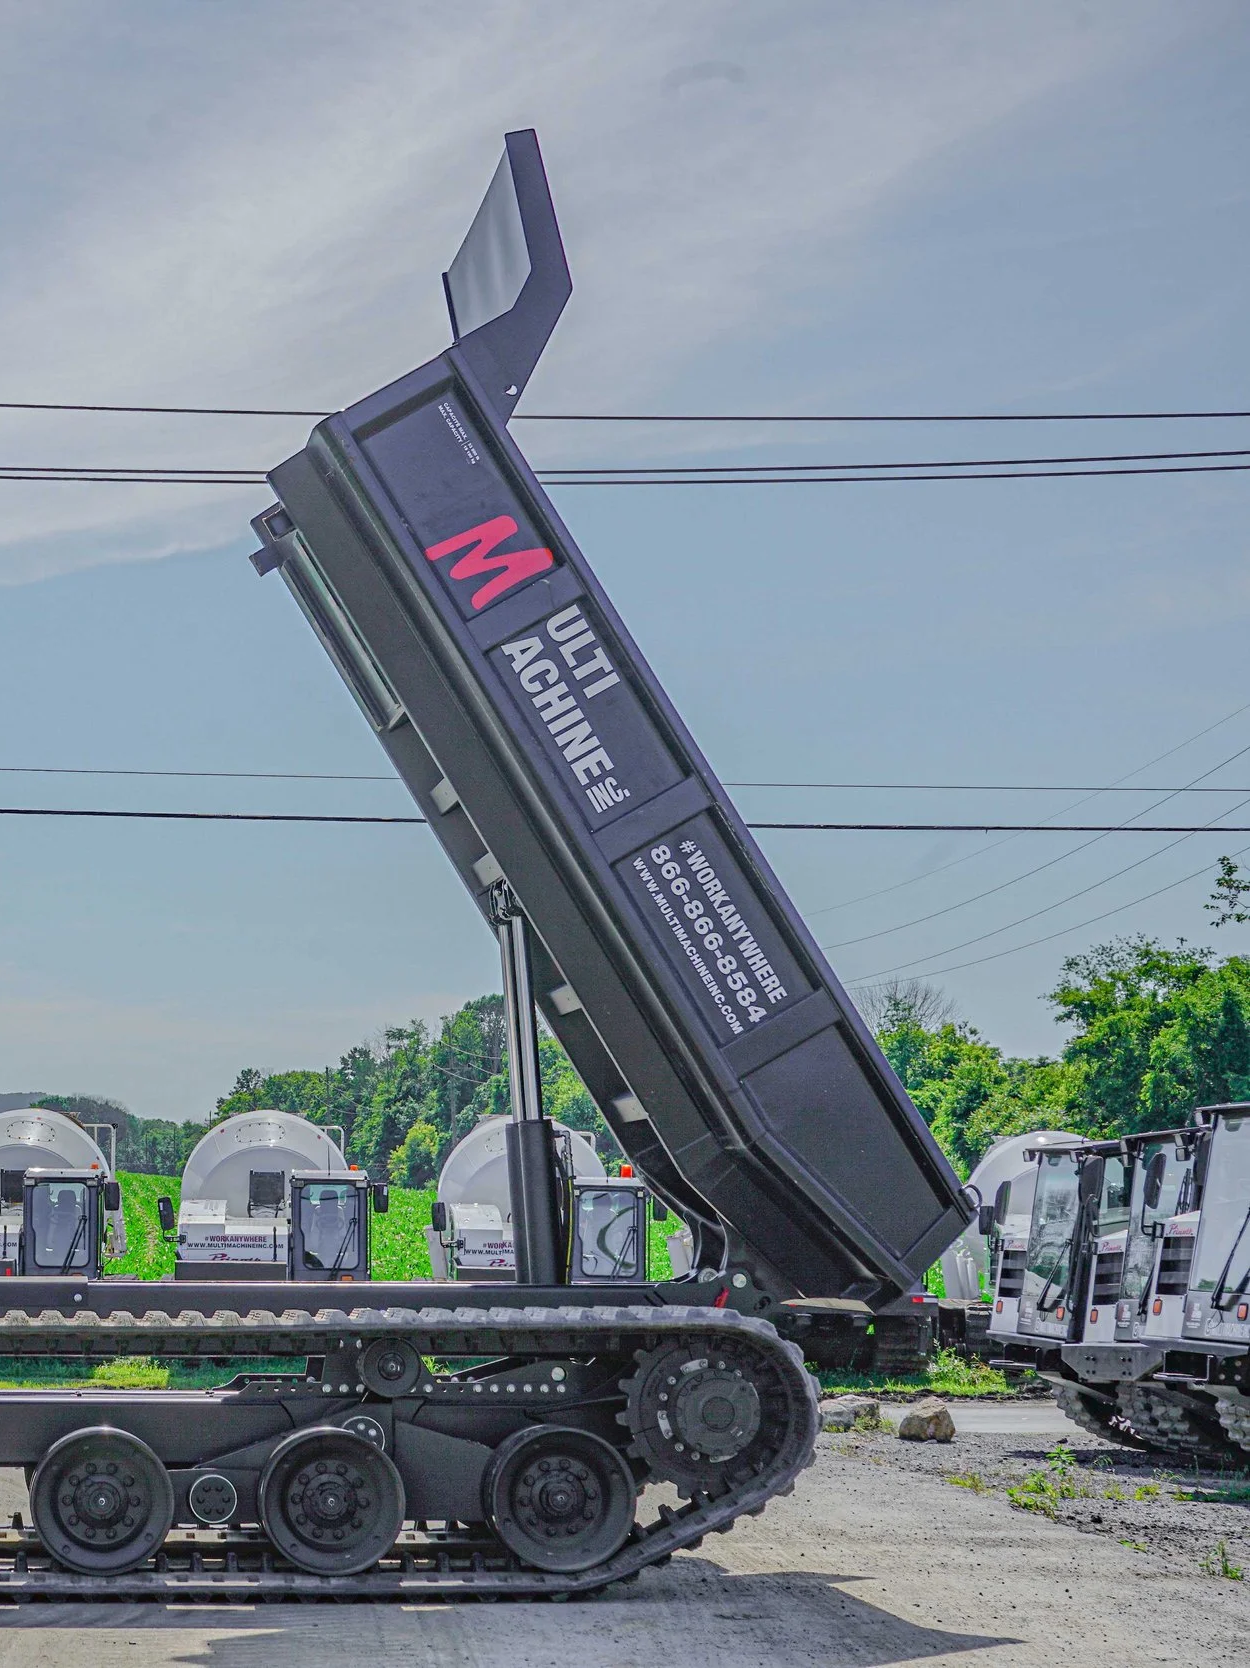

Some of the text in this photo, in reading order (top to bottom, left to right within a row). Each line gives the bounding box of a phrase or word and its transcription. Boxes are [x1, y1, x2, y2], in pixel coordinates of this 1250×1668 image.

[445, 418, 463, 443] CAPACITY
[425, 515, 554, 610] M
[546, 604, 621, 699] ULTI
[501, 636, 631, 814] ACHINE INC.
[632, 856, 744, 1035] WWW.MULTIMACHINEINC.COM
[650, 844, 767, 1023] 866-866-8584
[679, 840, 788, 1004] #WORKANYWHERE
[204, 1235, 267, 1243] #WORKANYWHERE
